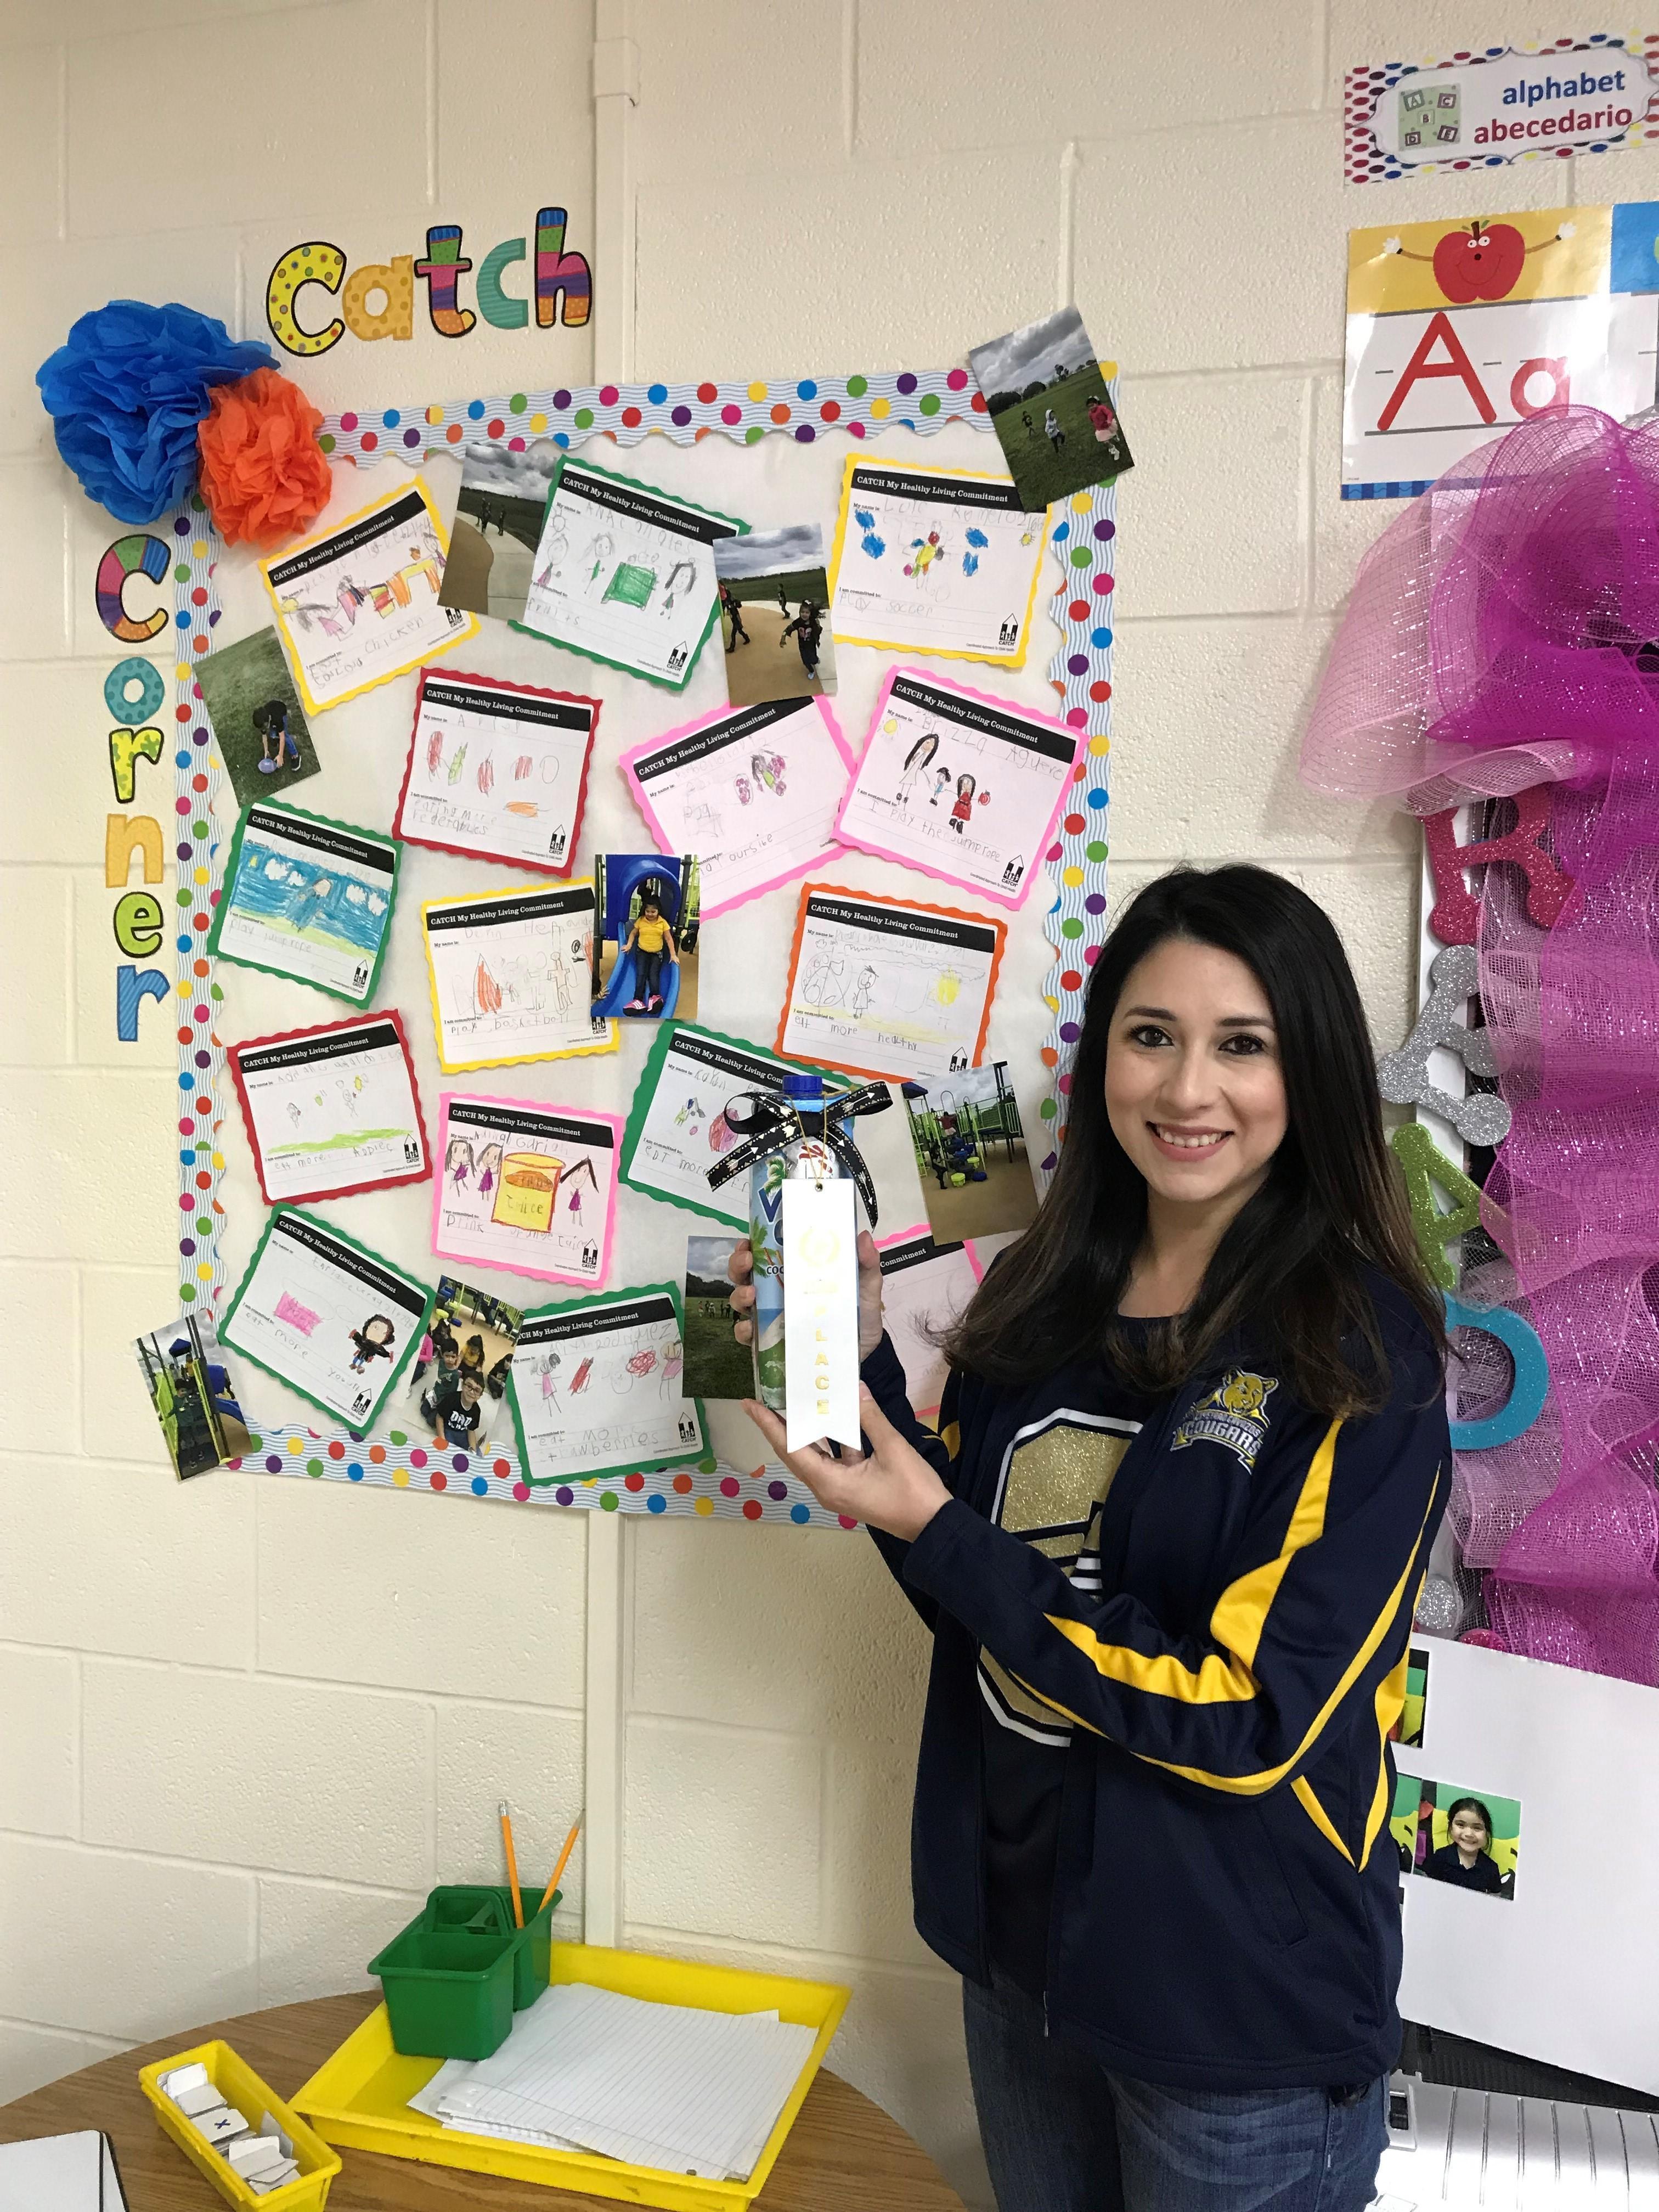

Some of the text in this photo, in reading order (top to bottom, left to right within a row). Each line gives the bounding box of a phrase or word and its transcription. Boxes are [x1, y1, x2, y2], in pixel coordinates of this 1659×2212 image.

[1502, 69, 1626, 106] alphabet
[1474, 104, 1633, 145] abecedario
[266, 207, 592, 357] Catch
[563, 477, 699, 533] CATCH My Healthy Living Commitment
[857, 476, 1008, 502] CATCH My Healthy Living Commitment
[273, 565, 297, 581] CATCH
[297, 561, 308, 570] My
[308, 548, 333, 564] Healthy
[334, 538, 354, 551] Living
[354, 515, 394, 541] Commitment
[426, 689, 558, 719] CATCH My Healthy Living Commitment
[896, 684, 1038, 743] CATCH My Healthy Living Commitment
[638, 759, 665, 775] CATCH
[664, 755, 678, 764] My
[678, 741, 706, 758] Healthy
[706, 730, 730, 745] Living
[729, 708, 776, 734] Commitment
[95, 534, 171, 1042] Corner
[252, 815, 275, 828] CATCH
[275, 822, 287, 832] My
[287, 826, 311, 840] Healthy
[311, 834, 331, 846] Living
[331, 840, 368, 858] Commitment
[1001, 878, 1018, 887] CATCH
[430, 915, 456, 925] CATCH
[469, 911, 496, 920] Healthy
[520, 900, 564, 913] Commitment
[811, 904, 958, 938] CATCH My Healthy Living Commitment
[830, 1024, 857, 1038] more
[244, 1057, 269, 1067] CATCH
[281, 1050, 307, 1060] Healthy
[308, 1046, 329, 1055] Living
[329, 1037, 369, 1050] Commitment
[674, 1040, 701, 1054] CATCH
[701, 1049, 714, 1060] My
[714, 1054, 743, 1070] Healthy
[743, 1064, 766, 1079] Living
[452, 1109, 580, 1136] CATCH My Healthy Living Commitment
[279, 1220, 396, 1293] CATCH My Healthy Living Commitment
[879, 1248, 926, 1268] Commitment
[544, 1325, 571, 1335] Healthy
[571, 1321, 593, 1330] Living
[593, 1312, 639, 1326] Commitment
[1182, 1420, 1261, 1456] COUGARS
